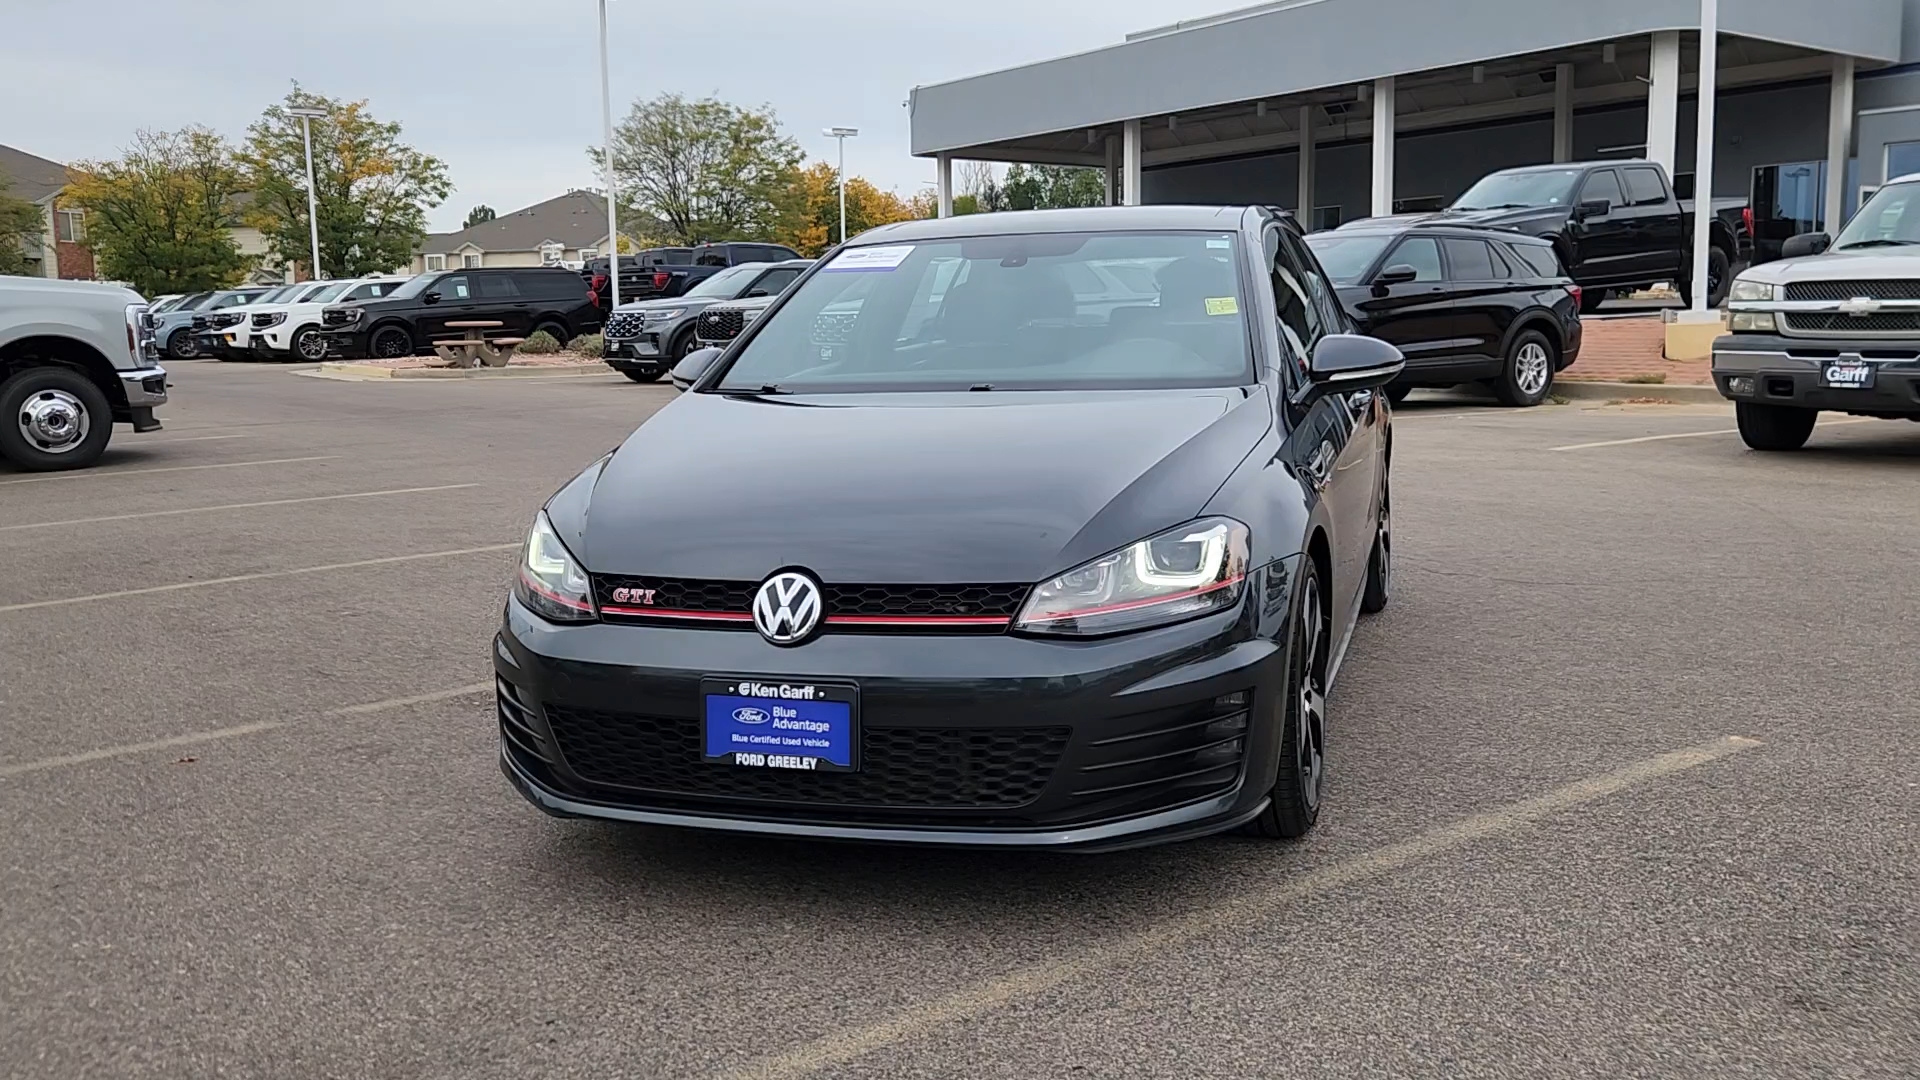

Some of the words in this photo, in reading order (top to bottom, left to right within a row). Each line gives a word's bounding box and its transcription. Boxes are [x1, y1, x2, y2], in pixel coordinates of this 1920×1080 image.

[1826, 366, 1869, 382] Garff
[612, 587, 656, 605] GTI
[751, 683, 778, 698] Ken
[779, 684, 815, 700] Garff
[738, 709, 764, 722] Ford
[773, 706, 797, 718] Blue
[772, 718, 830, 733] Advantage
[732, 734, 748, 743] Blue
[750, 735, 781, 745] Certified
[782, 737, 801, 746] Used
[803, 737, 830, 748] Vehicle
[736, 753, 765, 767] FORD
[767, 754, 818, 770] GREELEY
